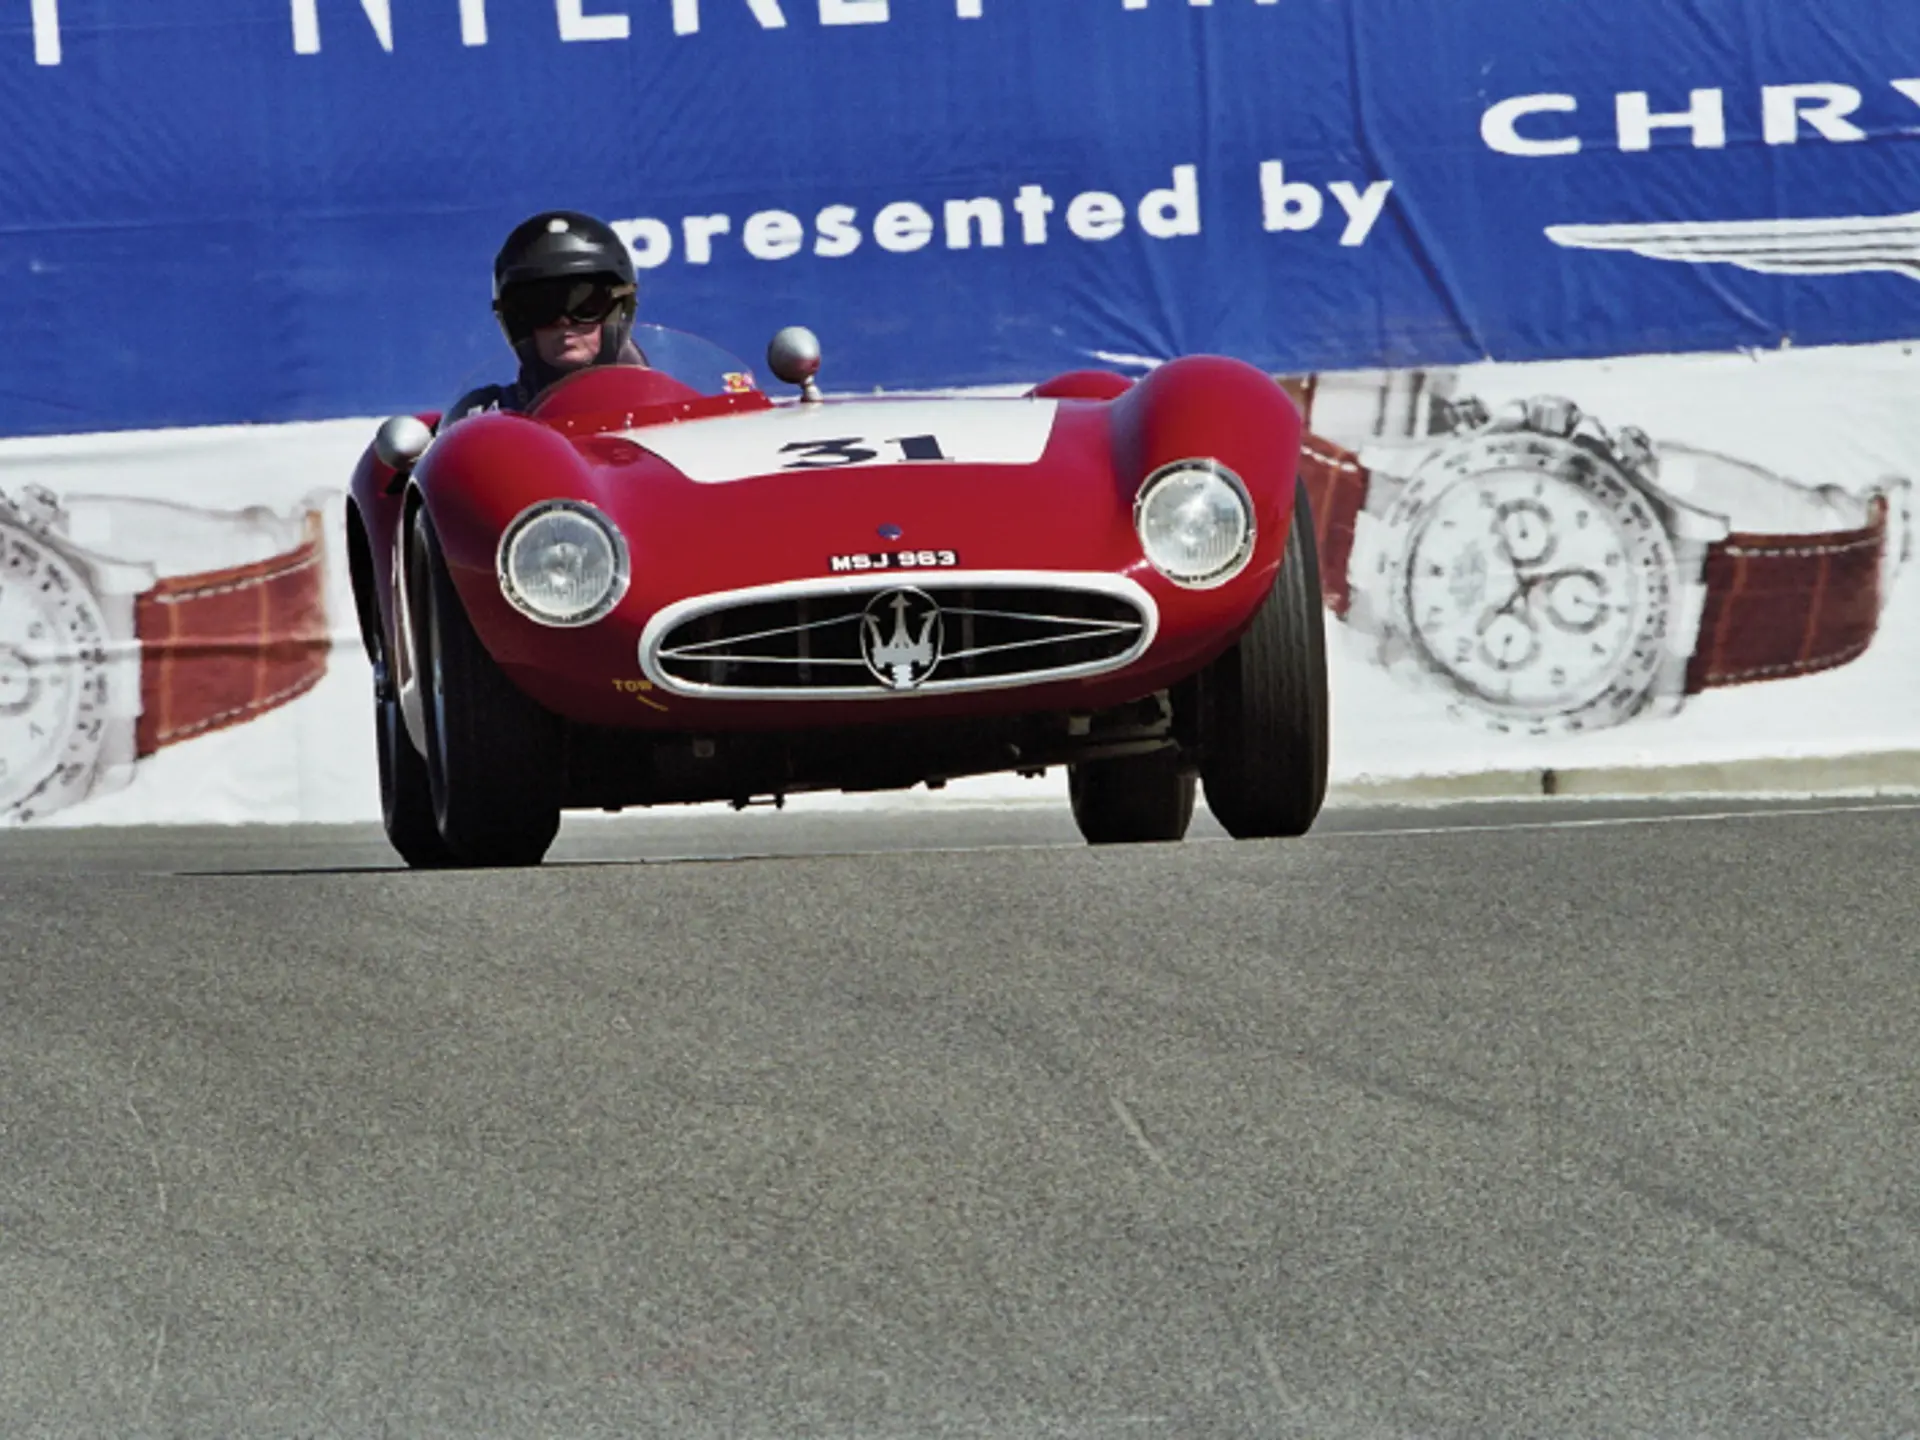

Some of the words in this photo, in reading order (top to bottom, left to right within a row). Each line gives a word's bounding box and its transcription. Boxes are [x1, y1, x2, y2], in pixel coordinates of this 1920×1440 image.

[608, 164, 1200, 269] presented
[1259, 159, 1393, 247] by
[777, 434, 955, 468] 31
[831, 553, 888, 571] MSJ
